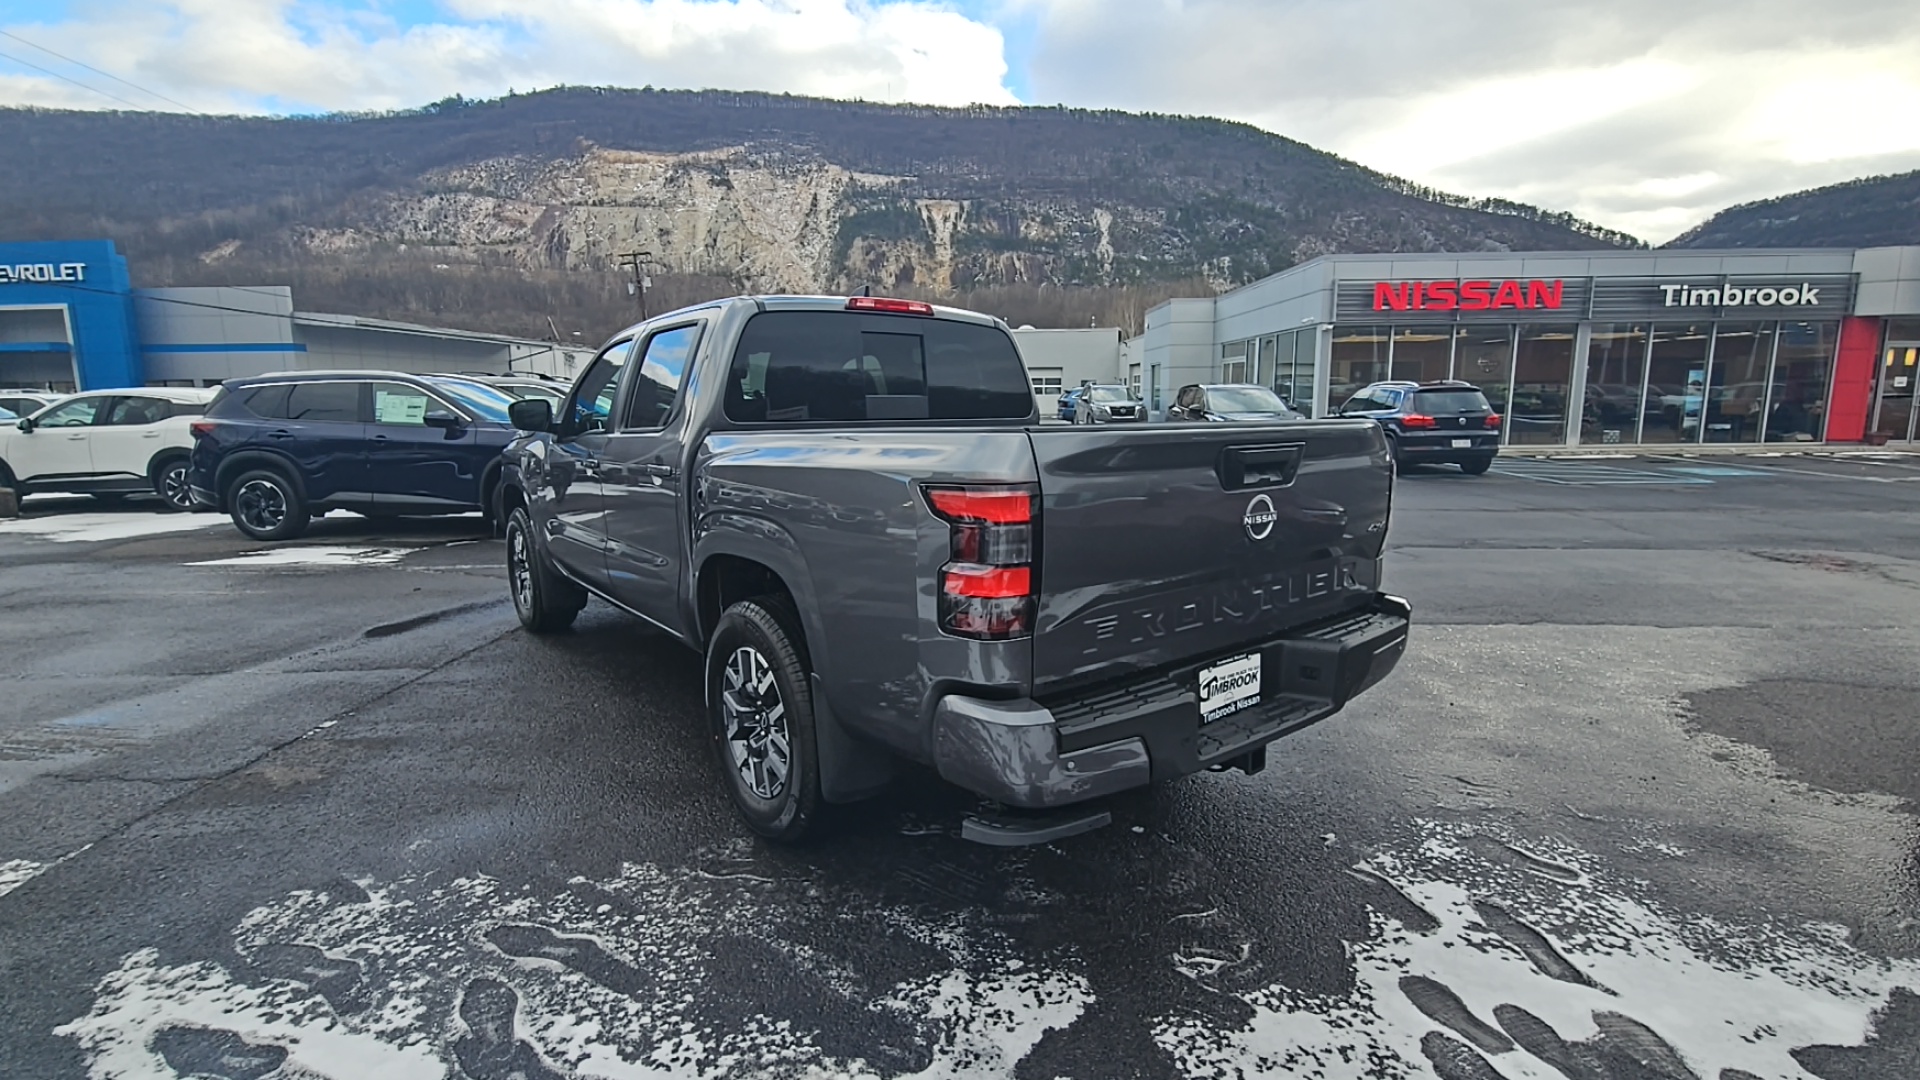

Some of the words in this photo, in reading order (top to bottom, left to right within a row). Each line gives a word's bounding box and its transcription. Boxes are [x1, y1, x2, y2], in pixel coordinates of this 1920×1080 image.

[1373, 279, 1564, 311] NISSAN
[1659, 282, 1820, 307] Timbrook
[1243, 512, 1277, 525] NISSAN
[1083, 563, 1362, 654] FRONTIER
[1200, 670, 1259, 702] TIMBROOK
[1203, 705, 1236, 724] Timbrook
[1236, 696, 1260, 710] Nissan
